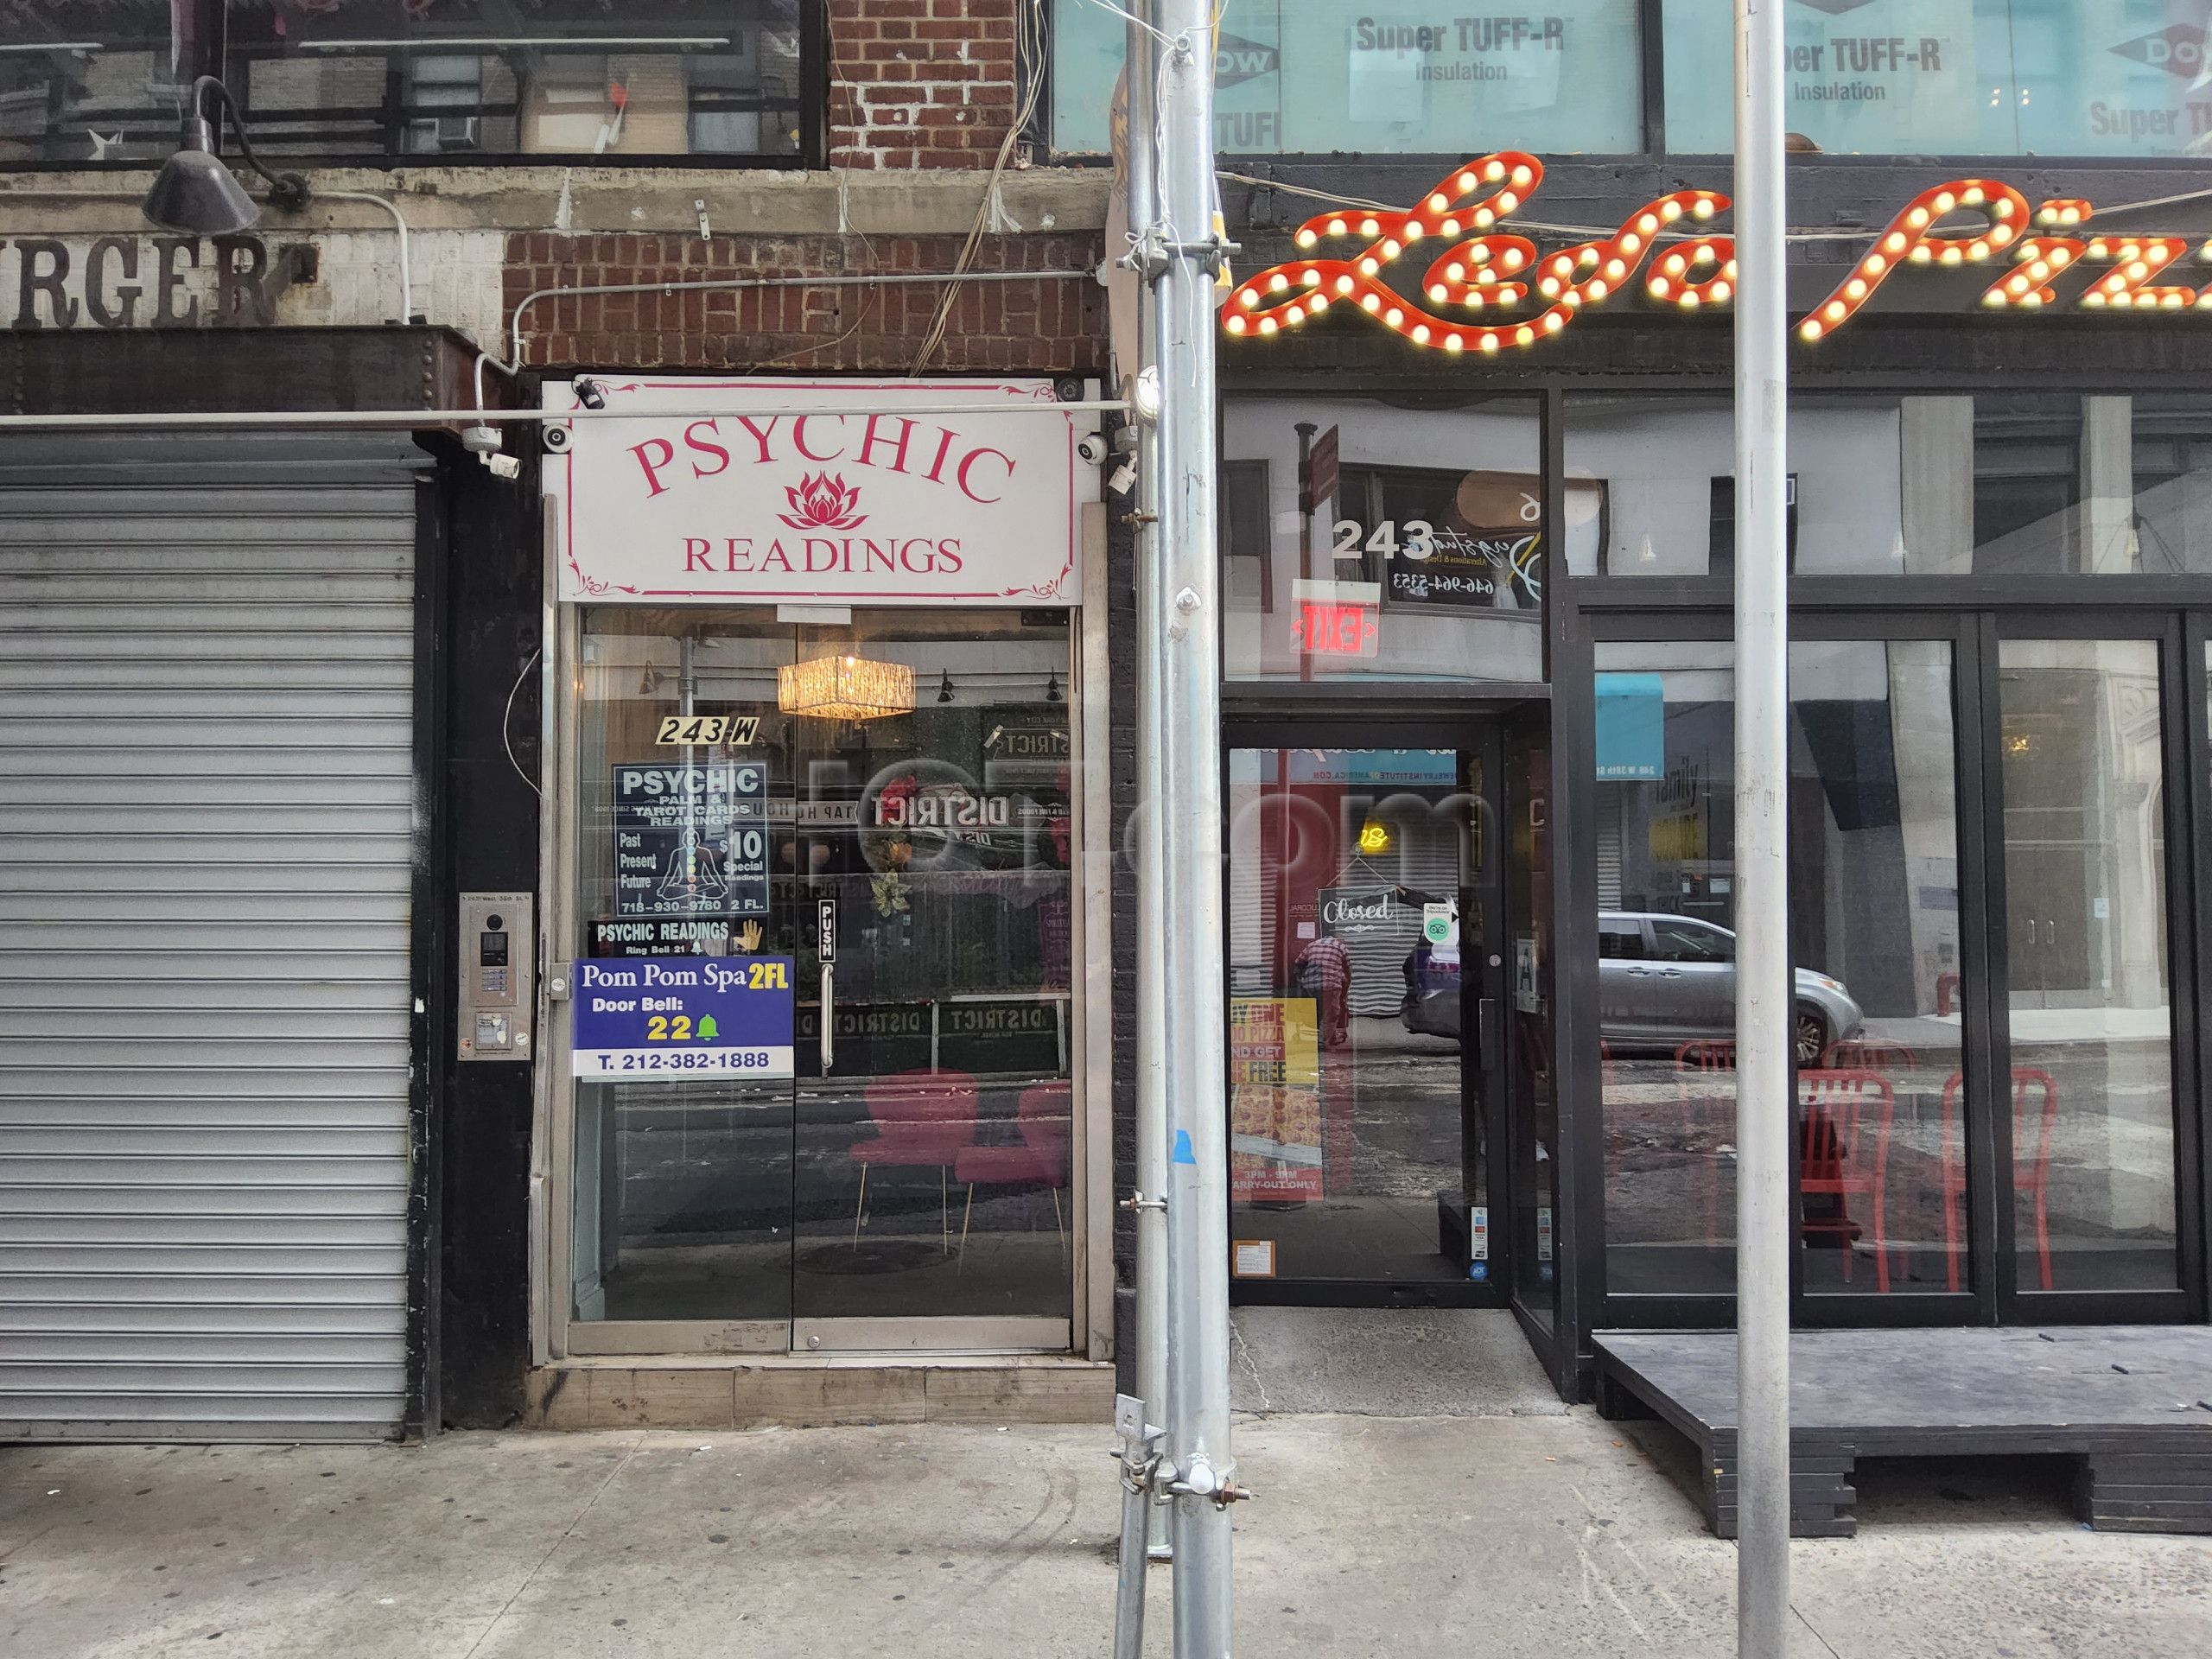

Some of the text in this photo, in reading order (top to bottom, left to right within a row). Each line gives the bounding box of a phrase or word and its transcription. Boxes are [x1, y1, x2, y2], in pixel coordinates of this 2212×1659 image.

[1356, 16, 1446, 60] Super
[1215, 50, 1272, 73] OW
[1415, 61, 1508, 81] Insulation
[1794, 81, 1886, 101] Insulation
[2089, 101, 2179, 145] Super
[1220, 150, 1737, 352] Ledo
[0, 234, 278, 328] RGER
[626, 413, 1018, 505] PSYCHIC
[1332, 519, 1433, 560] 243
[681, 537, 964, 575] READINGS
[660, 718, 757, 743] 243 W
[623, 768, 759, 795] PSYCHIC
[635, 805, 685, 817] TAROT
[695, 804, 751, 816] CARDS
[658, 795, 702, 805] PALM
[650, 816, 734, 827] READINGS
[620, 832, 641, 848] Past
[719, 830, 762, 860] $10
[620, 853, 657, 868] Present
[722, 861, 763, 874] Special
[620, 874, 652, 889] Future
[621, 899, 764, 913] 718-930-9780 2 FL.
[1323, 893, 1395, 925] Closed
[597, 921, 729, 943] PSYCHIC READINGS
[821, 906, 832, 957] PUSH
[626, 945, 685, 956] Ring Bell 21
[582, 963, 790, 993] Pom Pom Spa 2FL
[592, 996, 683, 1013] Door Bell:
[1250, 1002, 1286, 1027] ONE
[647, 1015, 692, 1040] 22
[1249, 1025, 1285, 1042] PIZZA
[597, 1052, 770, 1071] T. 212-382-1888
[1254, 1046, 1281, 1058] GET
[1249, 1061, 1287, 1083] FREE
[1244, 1170, 1267, 1179] 3PM
[1287, 1181, 1318, 1190] ONLY
